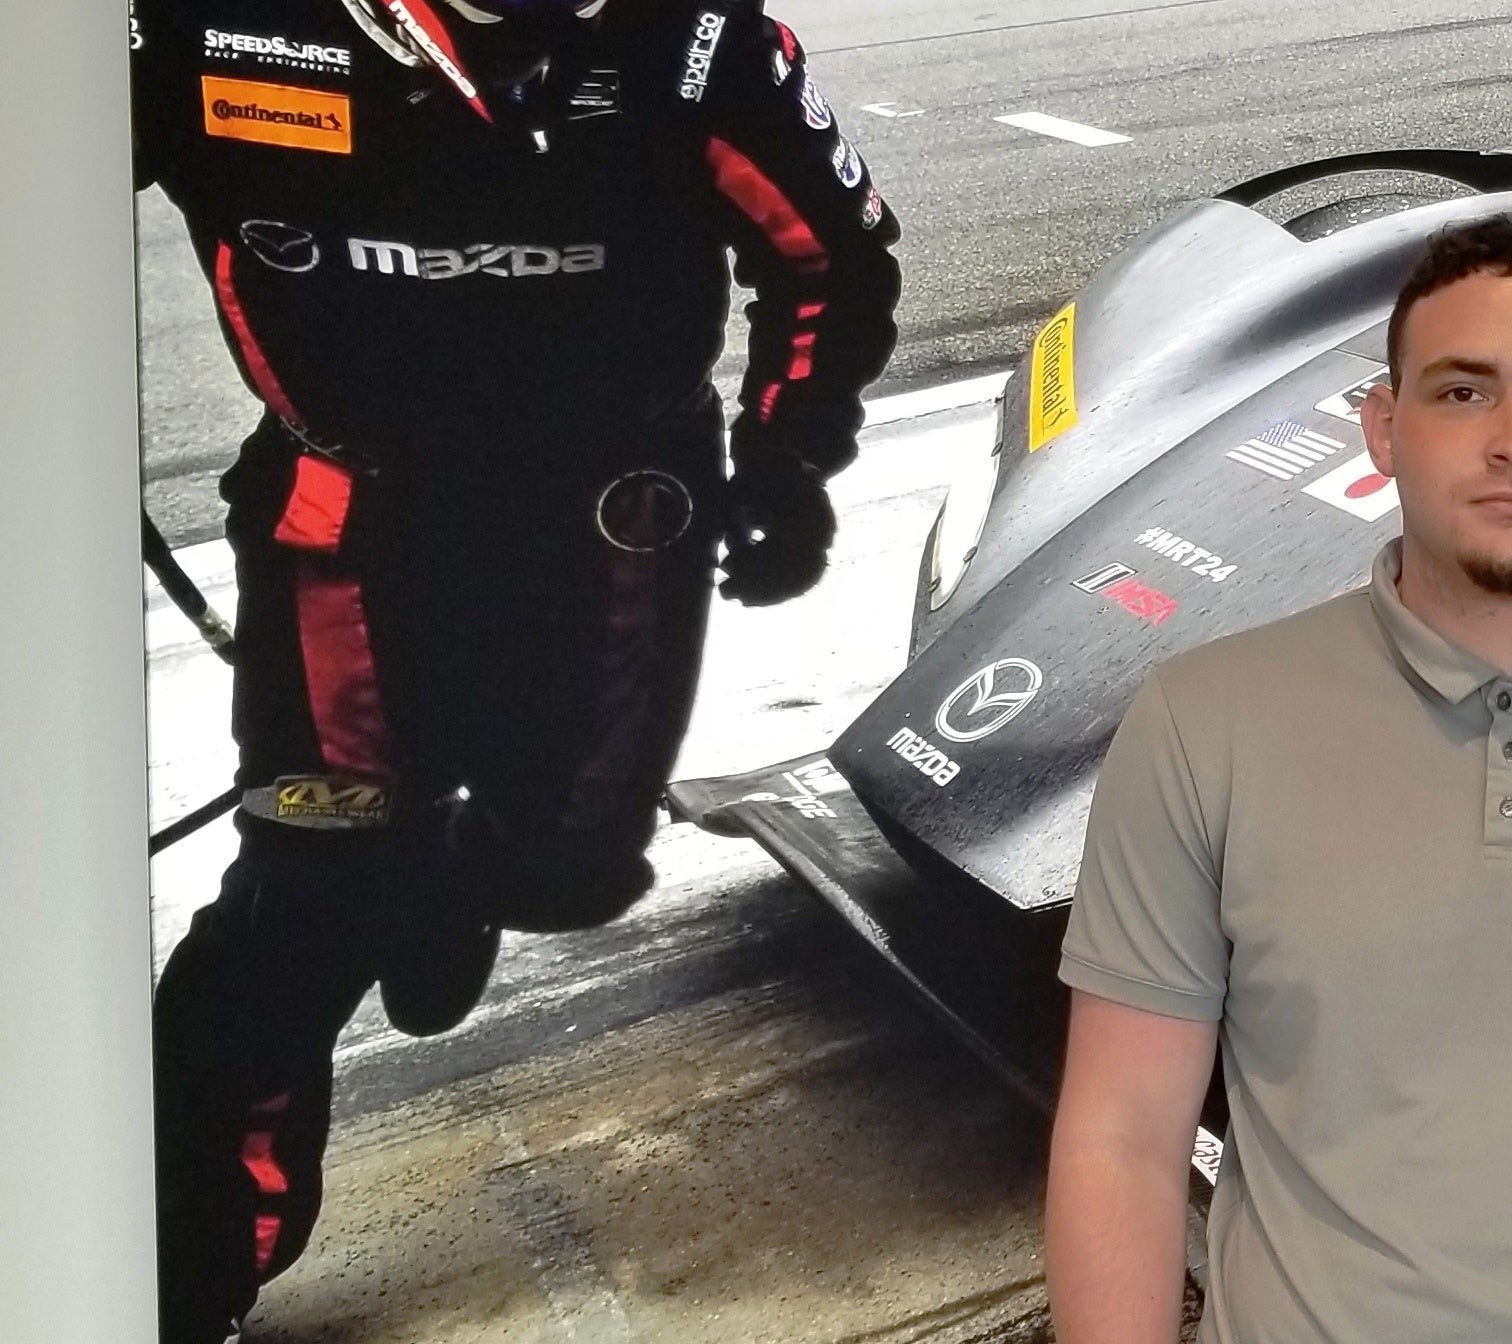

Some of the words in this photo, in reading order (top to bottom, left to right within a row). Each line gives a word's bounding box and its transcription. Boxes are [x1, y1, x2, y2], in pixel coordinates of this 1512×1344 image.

[388, 0, 477, 99] mazda
[679, 12, 725, 102] sparco
[211, 98, 323, 129] Continental
[348, 237, 605, 279] mazda
[1039, 317, 1069, 417] Continental
[1133, 526, 1239, 583] #MRT24
[885, 726, 961, 788] mazda
